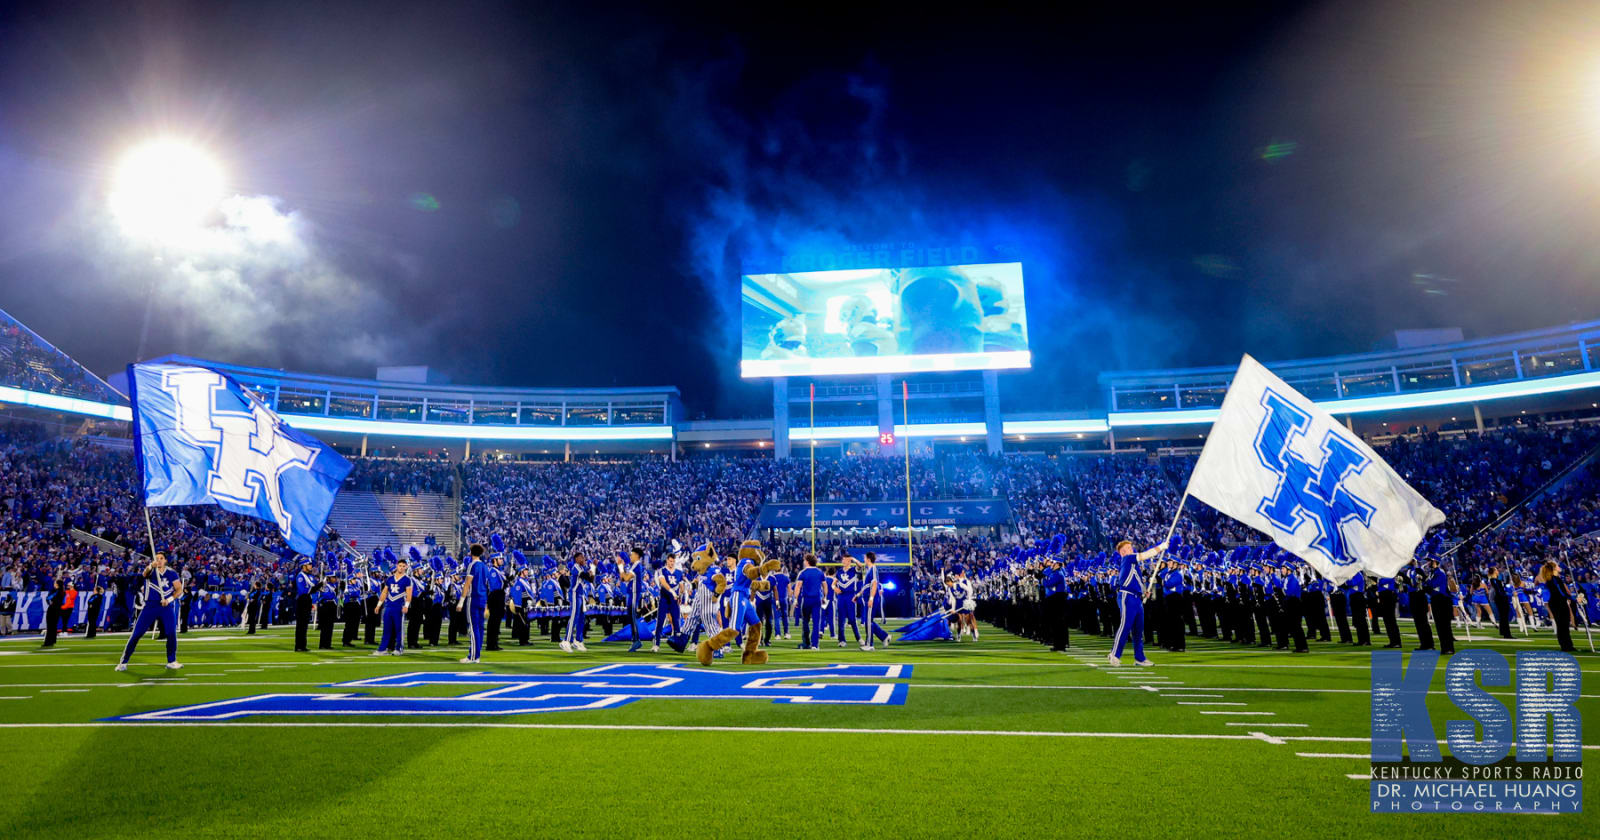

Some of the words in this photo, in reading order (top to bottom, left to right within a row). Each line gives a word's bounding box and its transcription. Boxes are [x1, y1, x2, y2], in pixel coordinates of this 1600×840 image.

[899, 245, 978, 266] FIELD
[880, 433, 893, 444] 25
[775, 505, 993, 518] KENTUCKY
